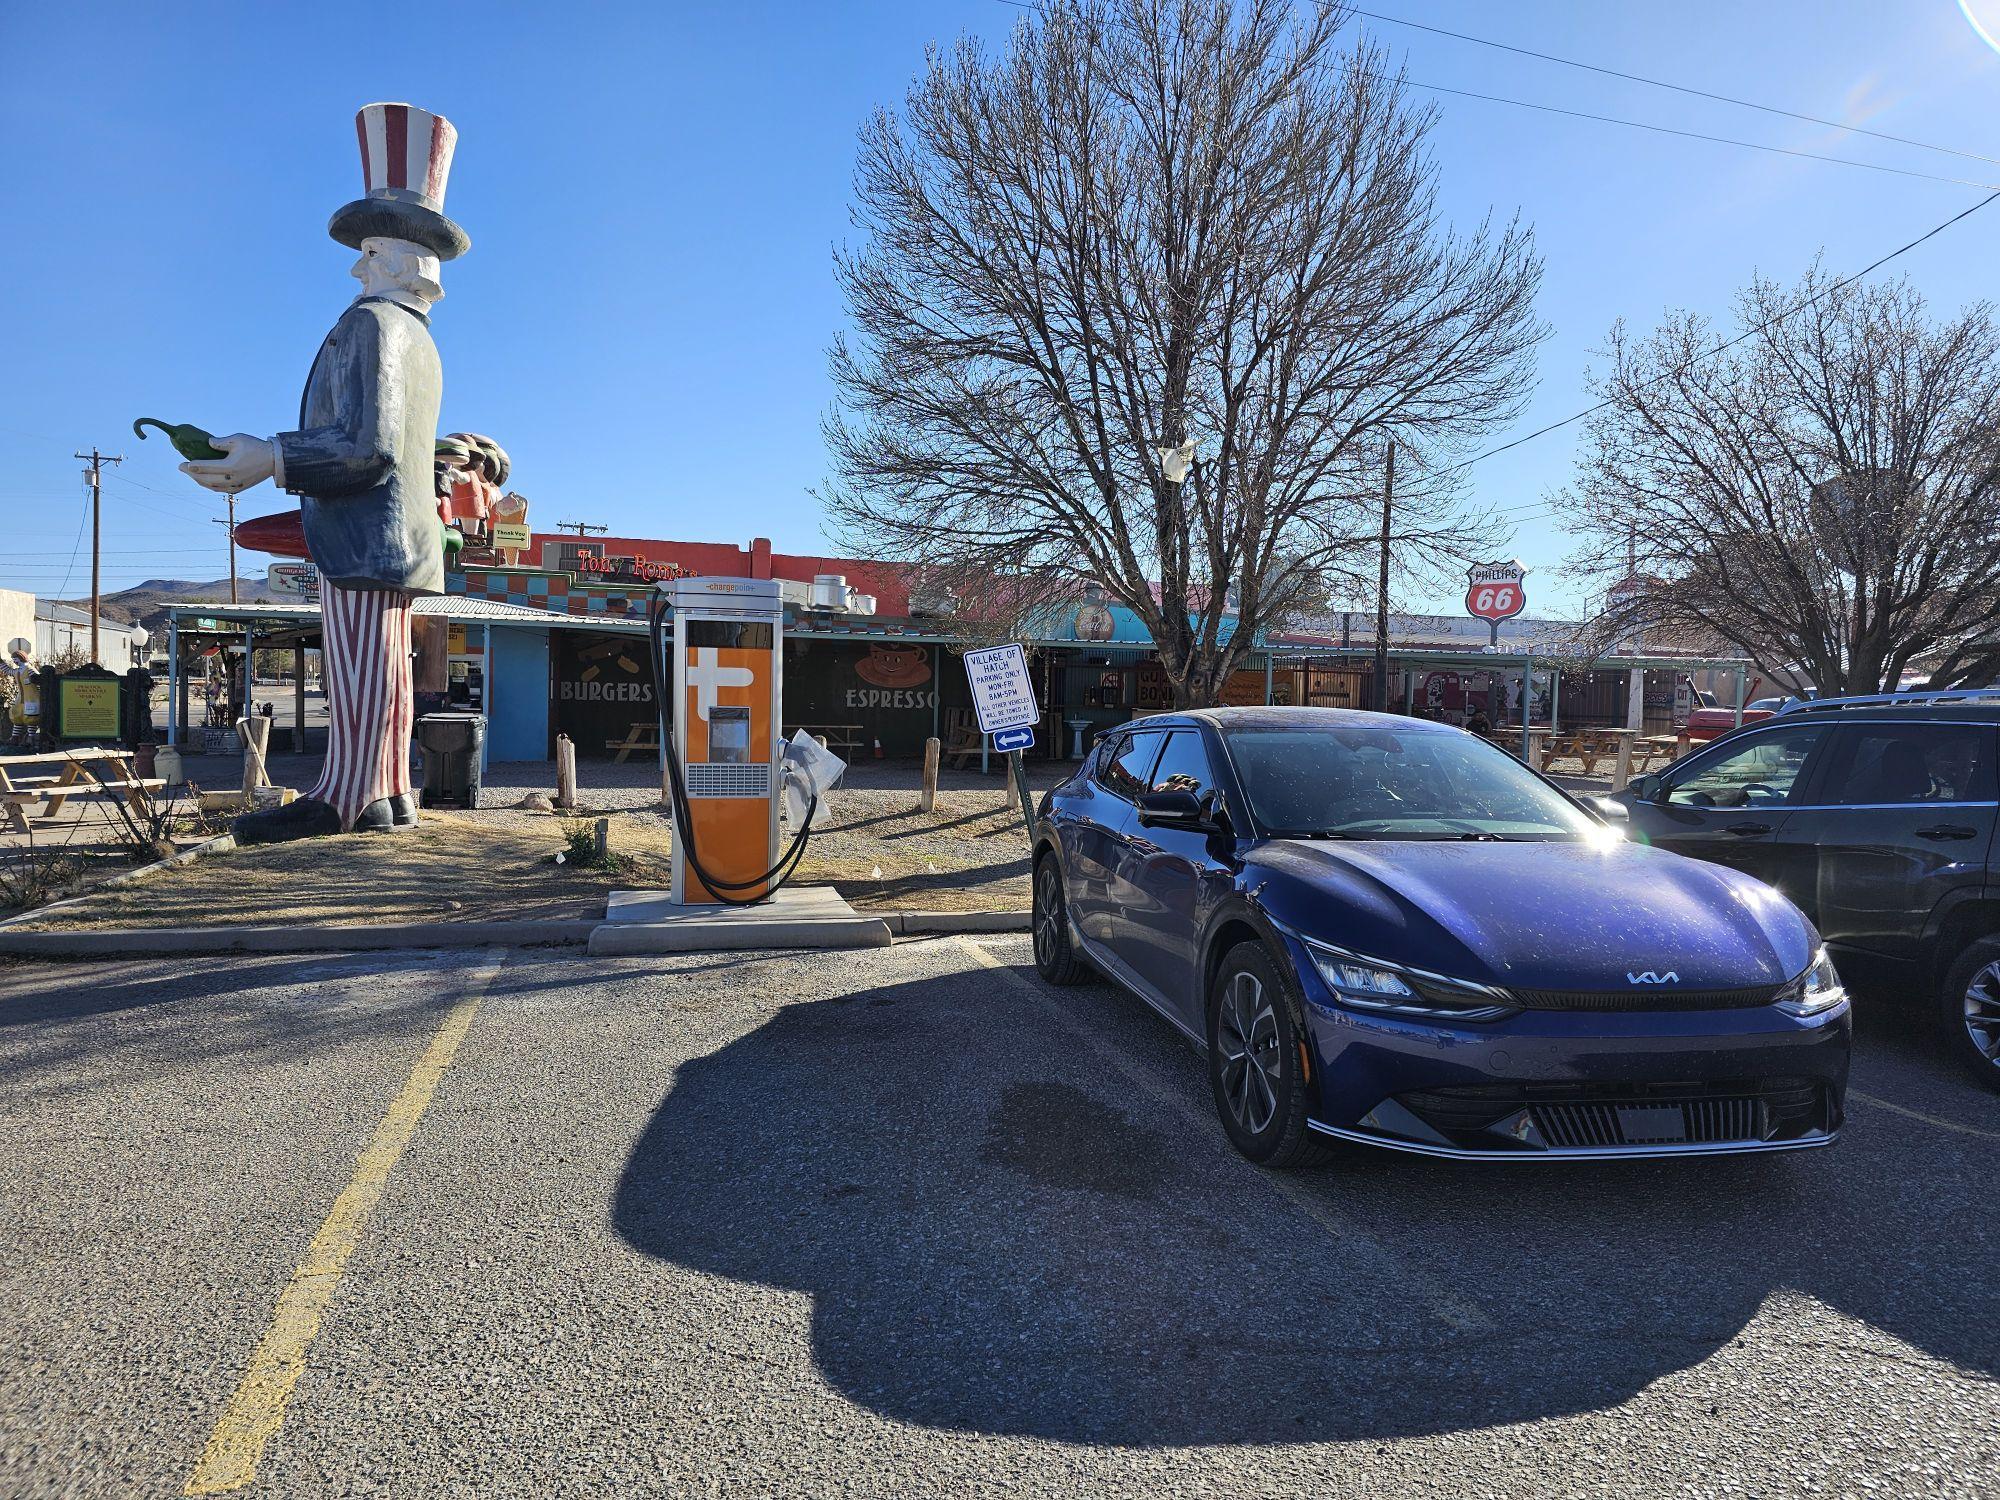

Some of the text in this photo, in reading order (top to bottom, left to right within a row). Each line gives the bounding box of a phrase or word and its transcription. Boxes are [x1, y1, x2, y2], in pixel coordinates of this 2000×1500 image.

[578, 549, 624, 577] Tony
[1475, 568, 1518, 581] PHILLIPS
[1476, 587, 1514, 611] 66
[970, 649, 1016, 665] VILLAGE OF
[983, 661, 1010, 673] HATCH
[976, 669, 1020, 684] PARKING ONLY
[560, 681, 653, 702] BURGERS
[988, 680, 1014, 691] MON-FRI
[845, 689, 940, 709] ESPRESSO
[988, 689, 1018, 701] 8AM-5PM
[991, 701, 1007, 710] OTHER
[1009, 697, 1030, 706] VEHICLES
[1006, 706, 1022, 715] TOWED
[1626, 971, 1680, 984] KIA
